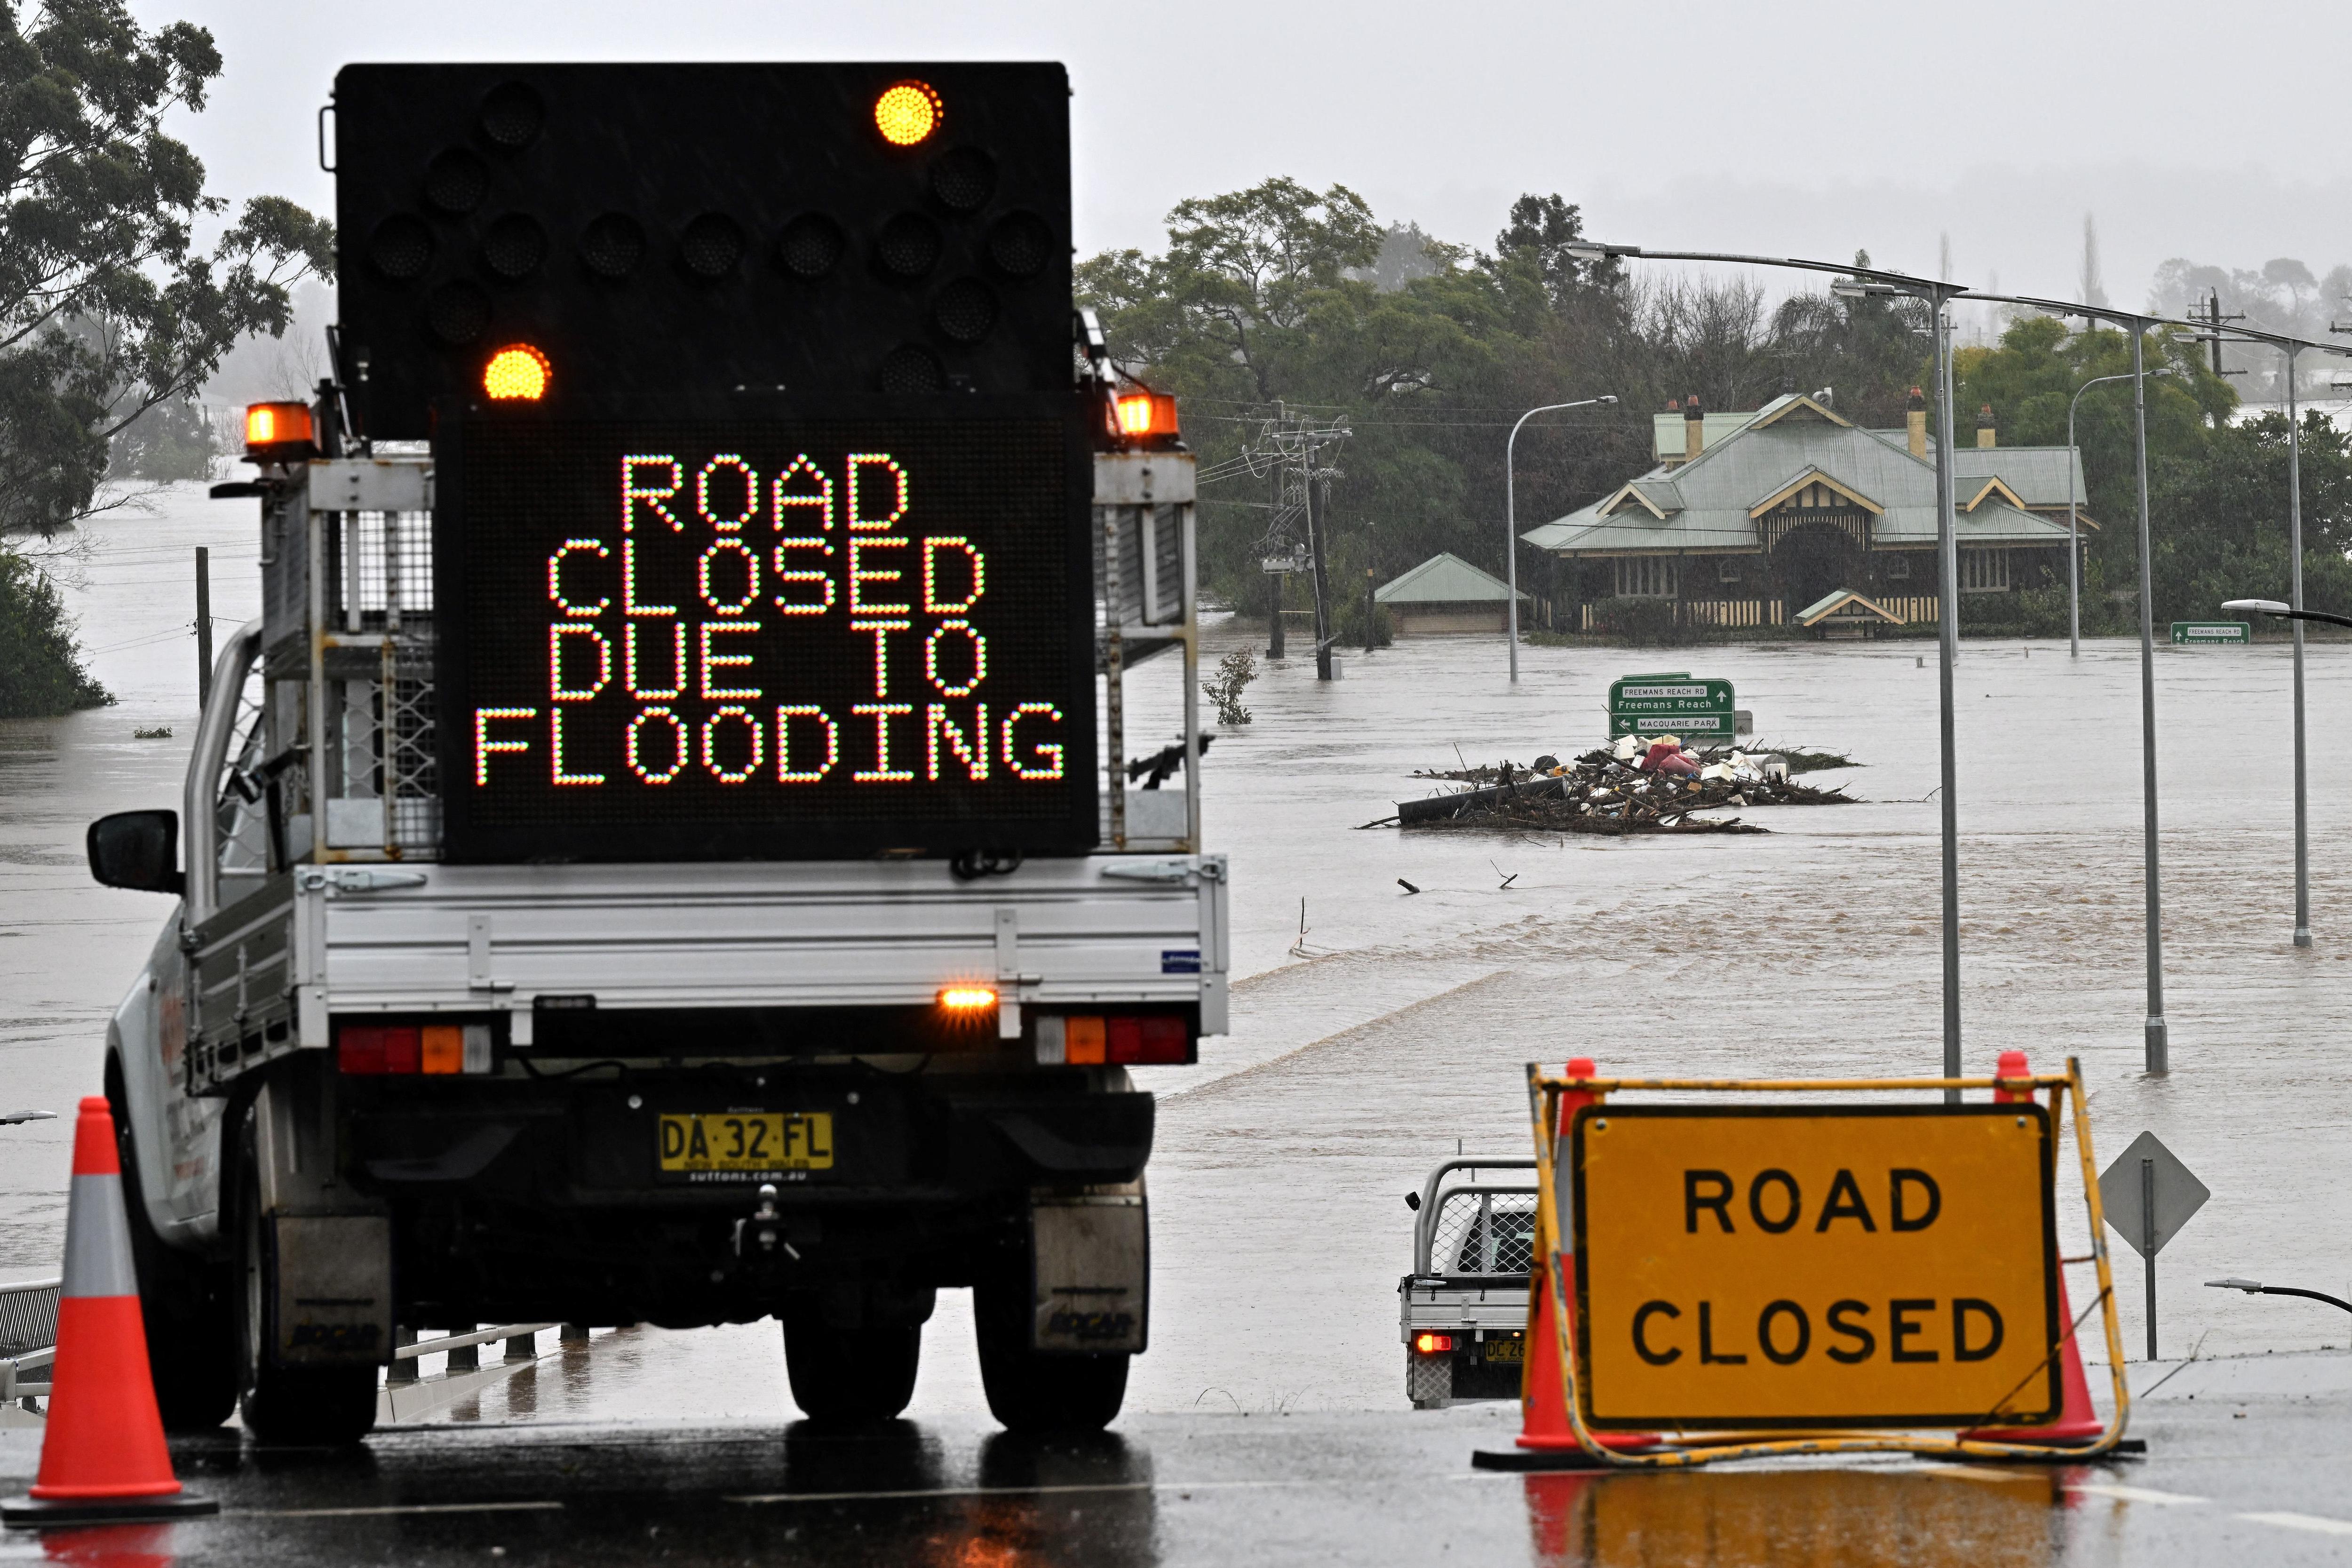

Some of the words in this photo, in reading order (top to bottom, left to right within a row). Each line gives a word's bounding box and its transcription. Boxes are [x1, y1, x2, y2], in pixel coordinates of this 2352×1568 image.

[623, 454, 908, 532] ROAD
[549, 536, 985, 616] CLOSED
[550, 621, 762, 700] DUE
[851, 620, 987, 697] TO
[476, 703, 1063, 785] FLOODING
[690, 1171, 807, 1181] suttons.com.au
[1683, 1167, 1942, 1235] ROAD
[1631, 1297, 2005, 1367] CLOSED
